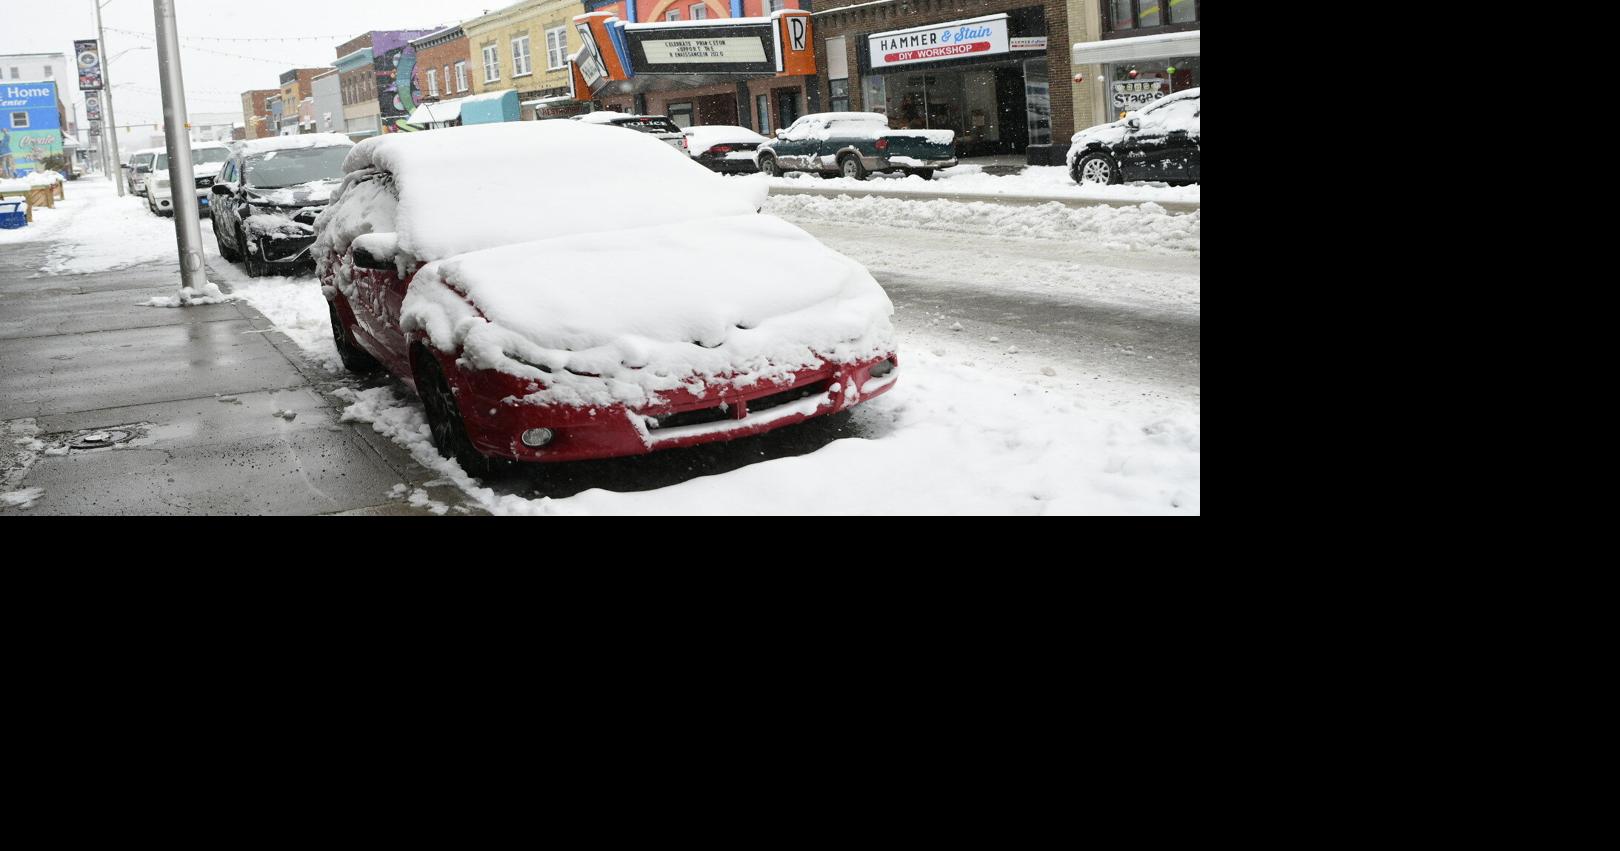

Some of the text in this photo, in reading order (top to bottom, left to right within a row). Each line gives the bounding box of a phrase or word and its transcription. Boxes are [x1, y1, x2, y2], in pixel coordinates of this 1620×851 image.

[790, 17, 804, 49] R
[880, 26, 993, 51] HAMMER & Stain
[898, 44, 973, 61] DIY WORKSHOP
[7, 87, 51, 98] Home
[0, 99, 27, 107] enter
